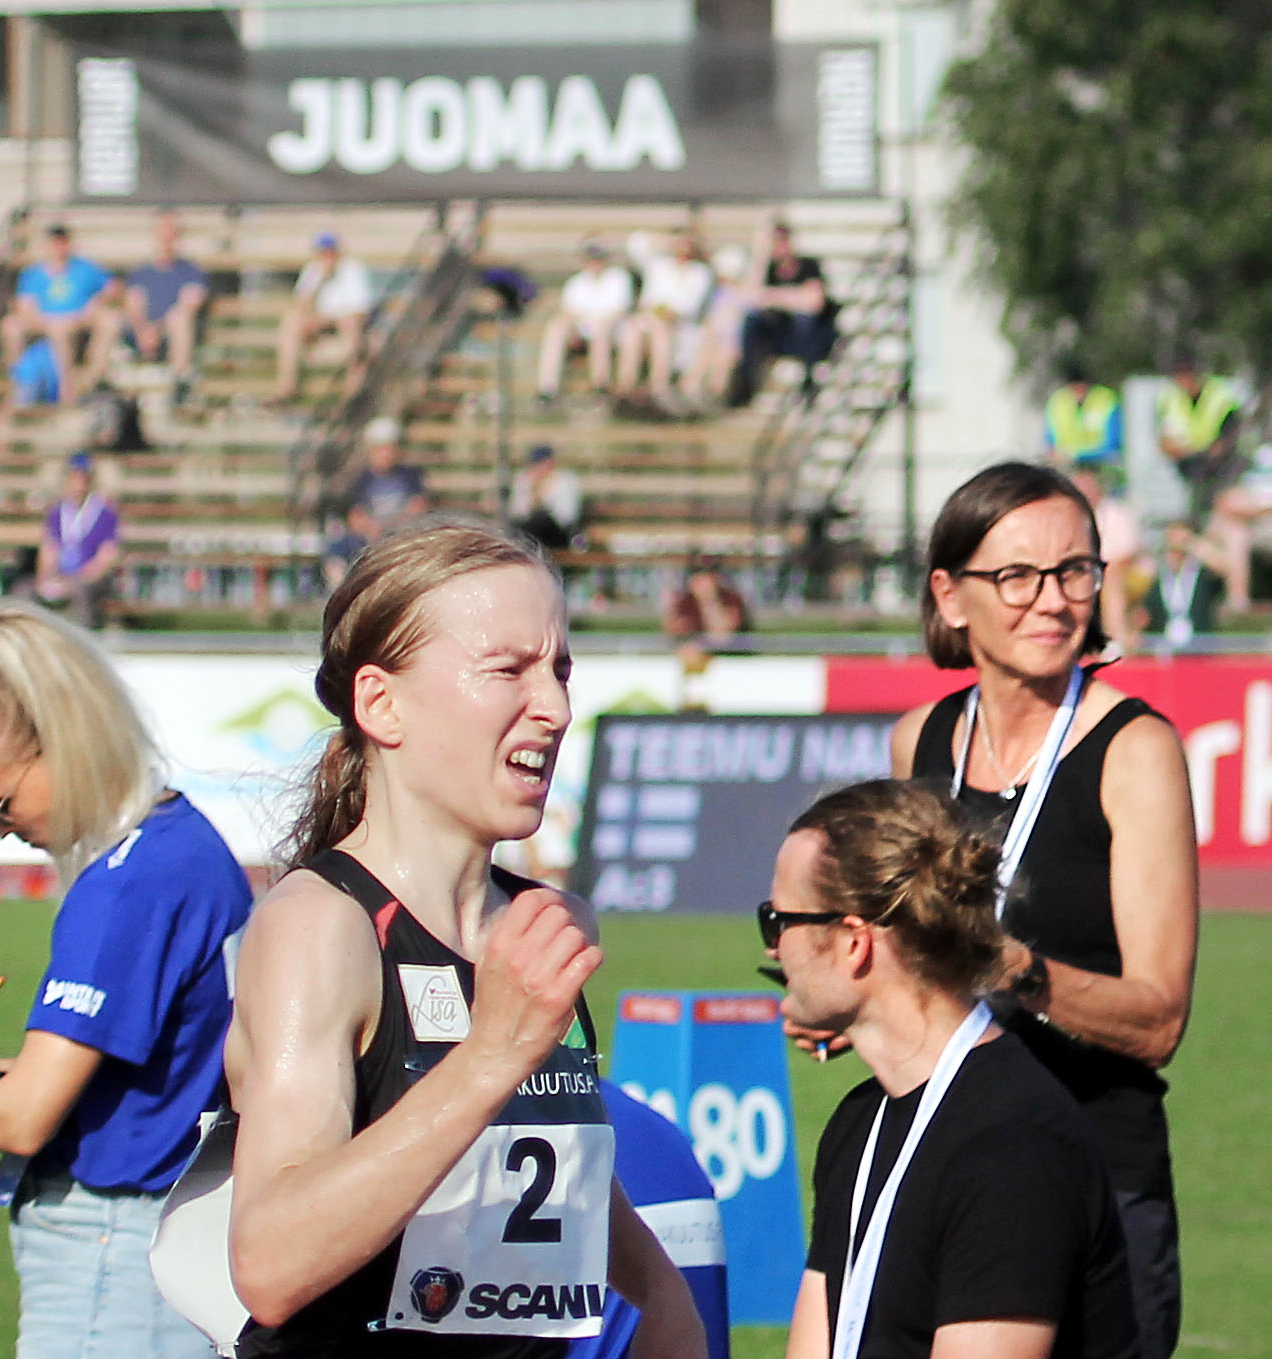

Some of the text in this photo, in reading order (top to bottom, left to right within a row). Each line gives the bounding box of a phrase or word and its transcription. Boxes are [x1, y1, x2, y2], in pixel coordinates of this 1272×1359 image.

[267, 75, 686, 175] JUOMAA
[603, 722, 796, 783] TEEMU
[501, 1137, 562, 1243] 2
[689, 1083, 787, 1200] 80
[464, 1283, 605, 1320] SCANI
